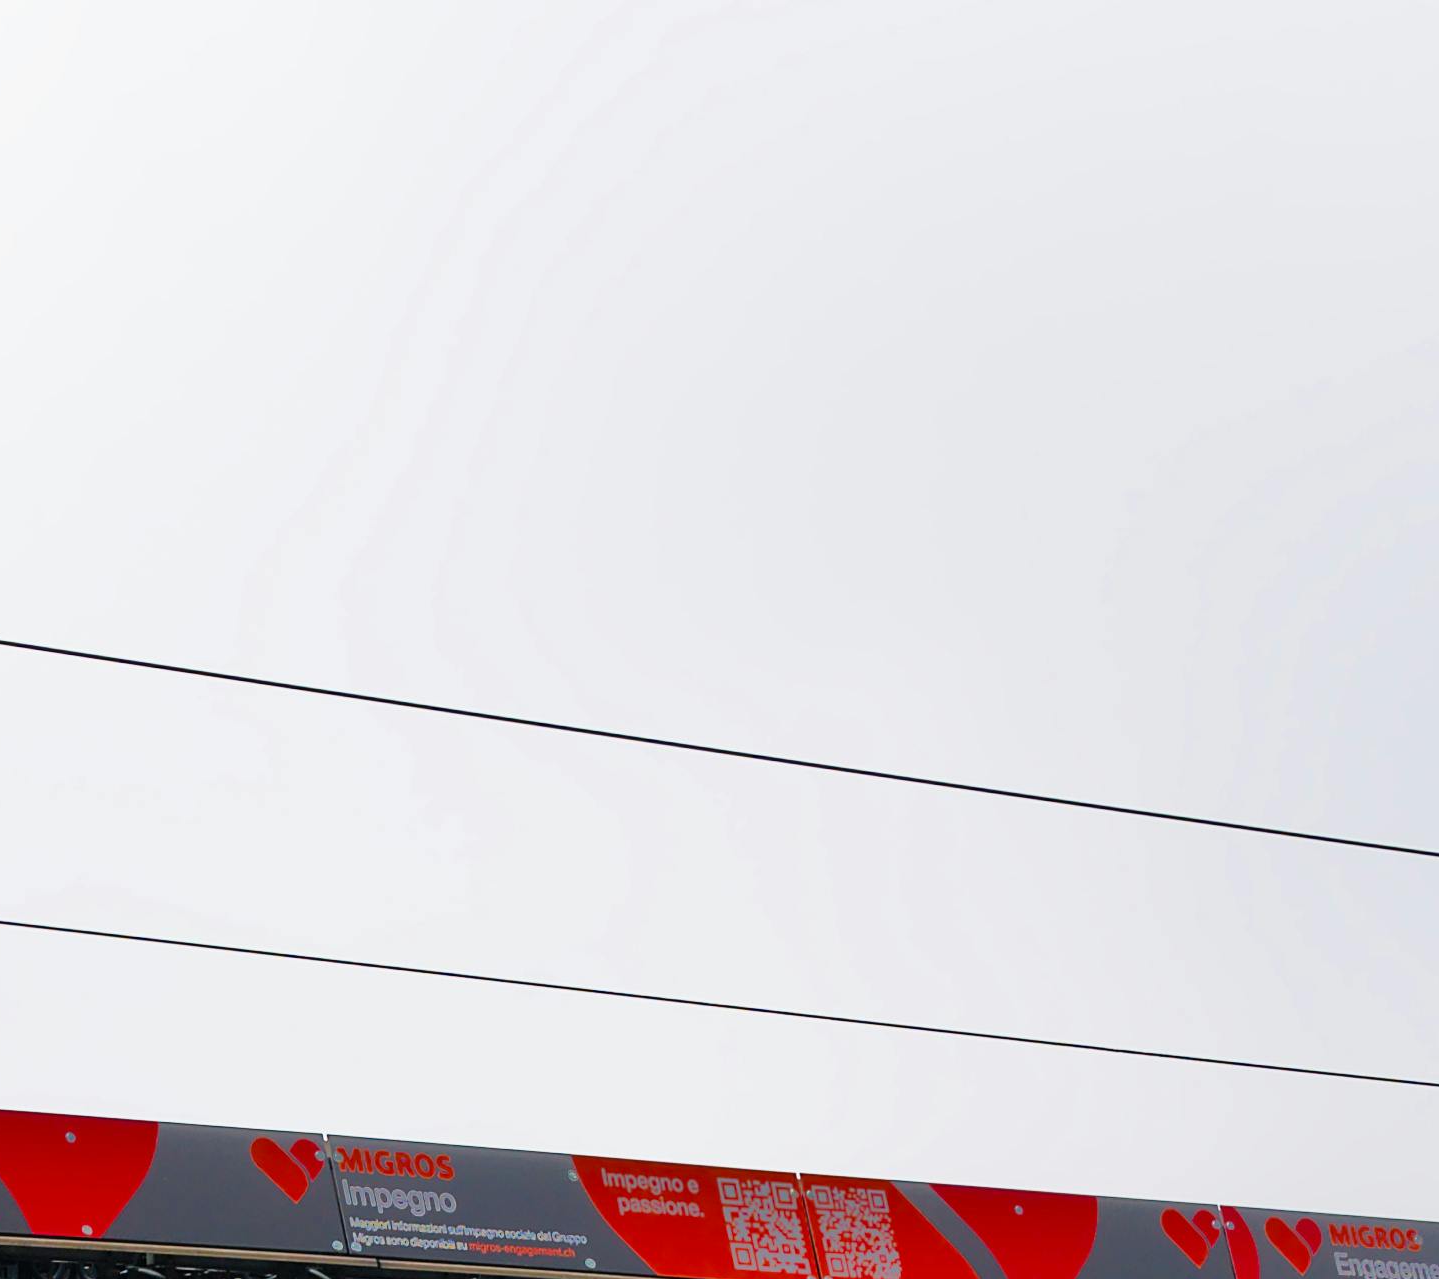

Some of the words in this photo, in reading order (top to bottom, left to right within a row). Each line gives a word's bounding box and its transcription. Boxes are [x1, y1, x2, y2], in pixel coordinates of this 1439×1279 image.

[336, 1146, 455, 1181] MIGROS
[601, 1168, 684, 1195] Impegno
[687, 1179, 699, 1194] e
[341, 1179, 456, 1216] Impegno
[617, 1196, 705, 1217] passione.
[1329, 1223, 1422, 1252] MIGROS
